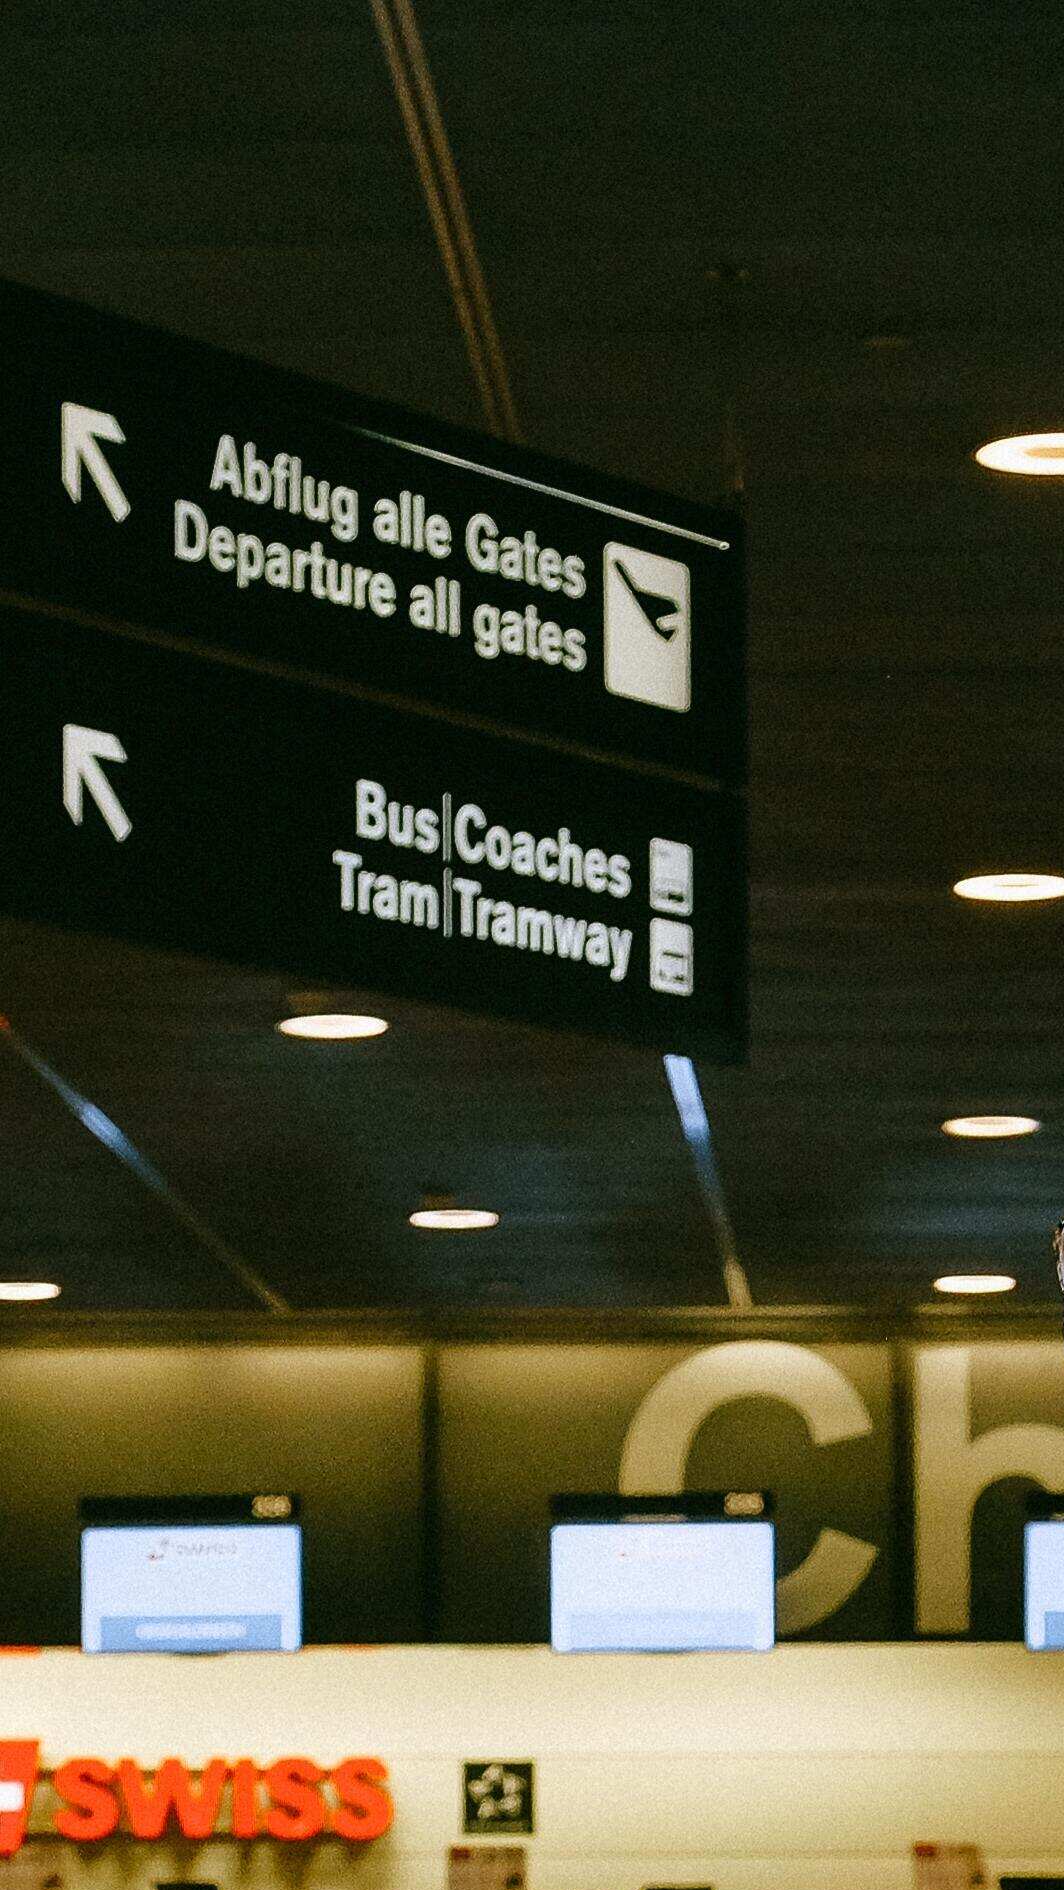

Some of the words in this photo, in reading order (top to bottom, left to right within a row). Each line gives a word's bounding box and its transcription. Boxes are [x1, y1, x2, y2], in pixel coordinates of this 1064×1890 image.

[210, 434, 359, 542] Abflug
[373, 490, 452, 560] alle
[465, 512, 587, 599] Gates
[174, 499, 397, 618] Departure
[408, 576, 461, 638] all
[473, 603, 587, 672] gates
[355, 778, 440, 854] Bus
[453, 803, 632, 899] Coaches
[332, 849, 440, 929] Tram
[452, 877, 633, 982] Tramway
[52, 1758, 394, 1841] SWISS
